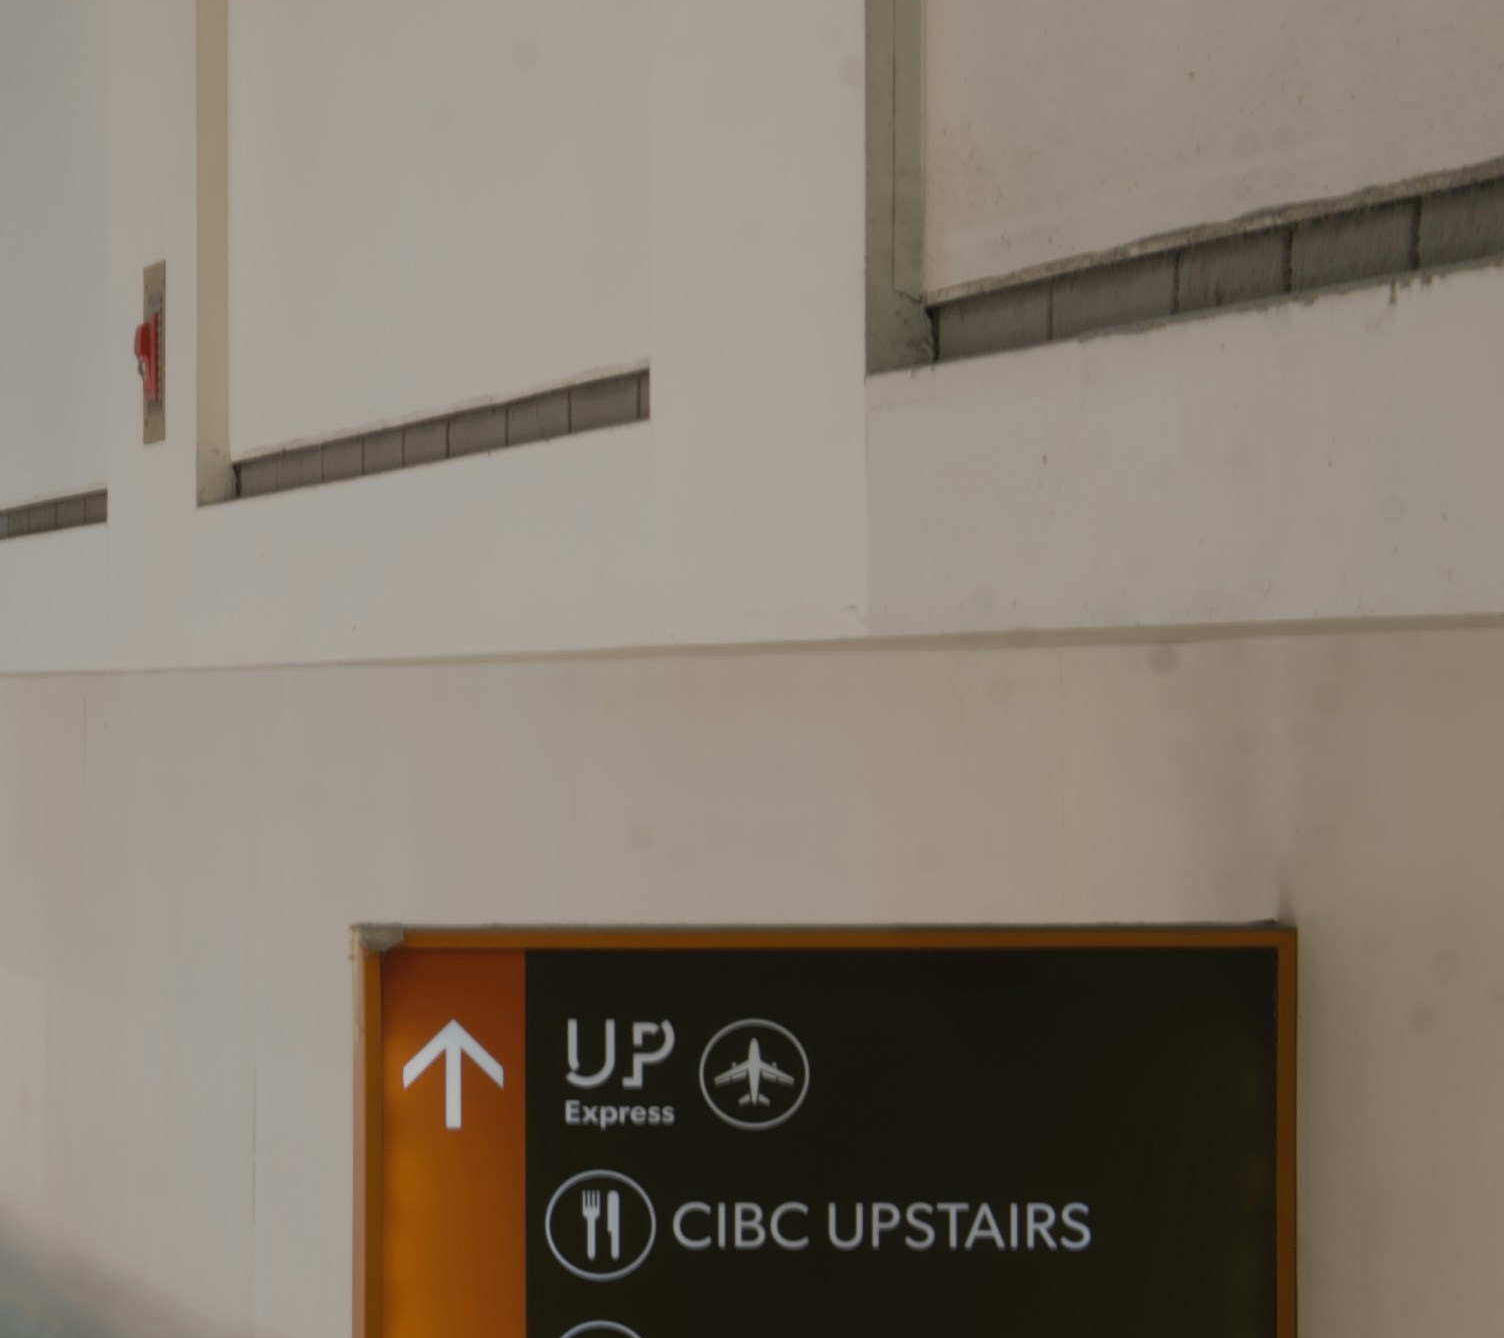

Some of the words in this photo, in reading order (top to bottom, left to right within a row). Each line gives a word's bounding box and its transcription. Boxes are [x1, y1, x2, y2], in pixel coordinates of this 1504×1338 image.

[565, 1018, 675, 1089] UP
[565, 1100, 675, 1129] Express
[672, 1201, 809, 1249] CIBC
[828, 1201, 1092, 1250] UPSTAIRS
